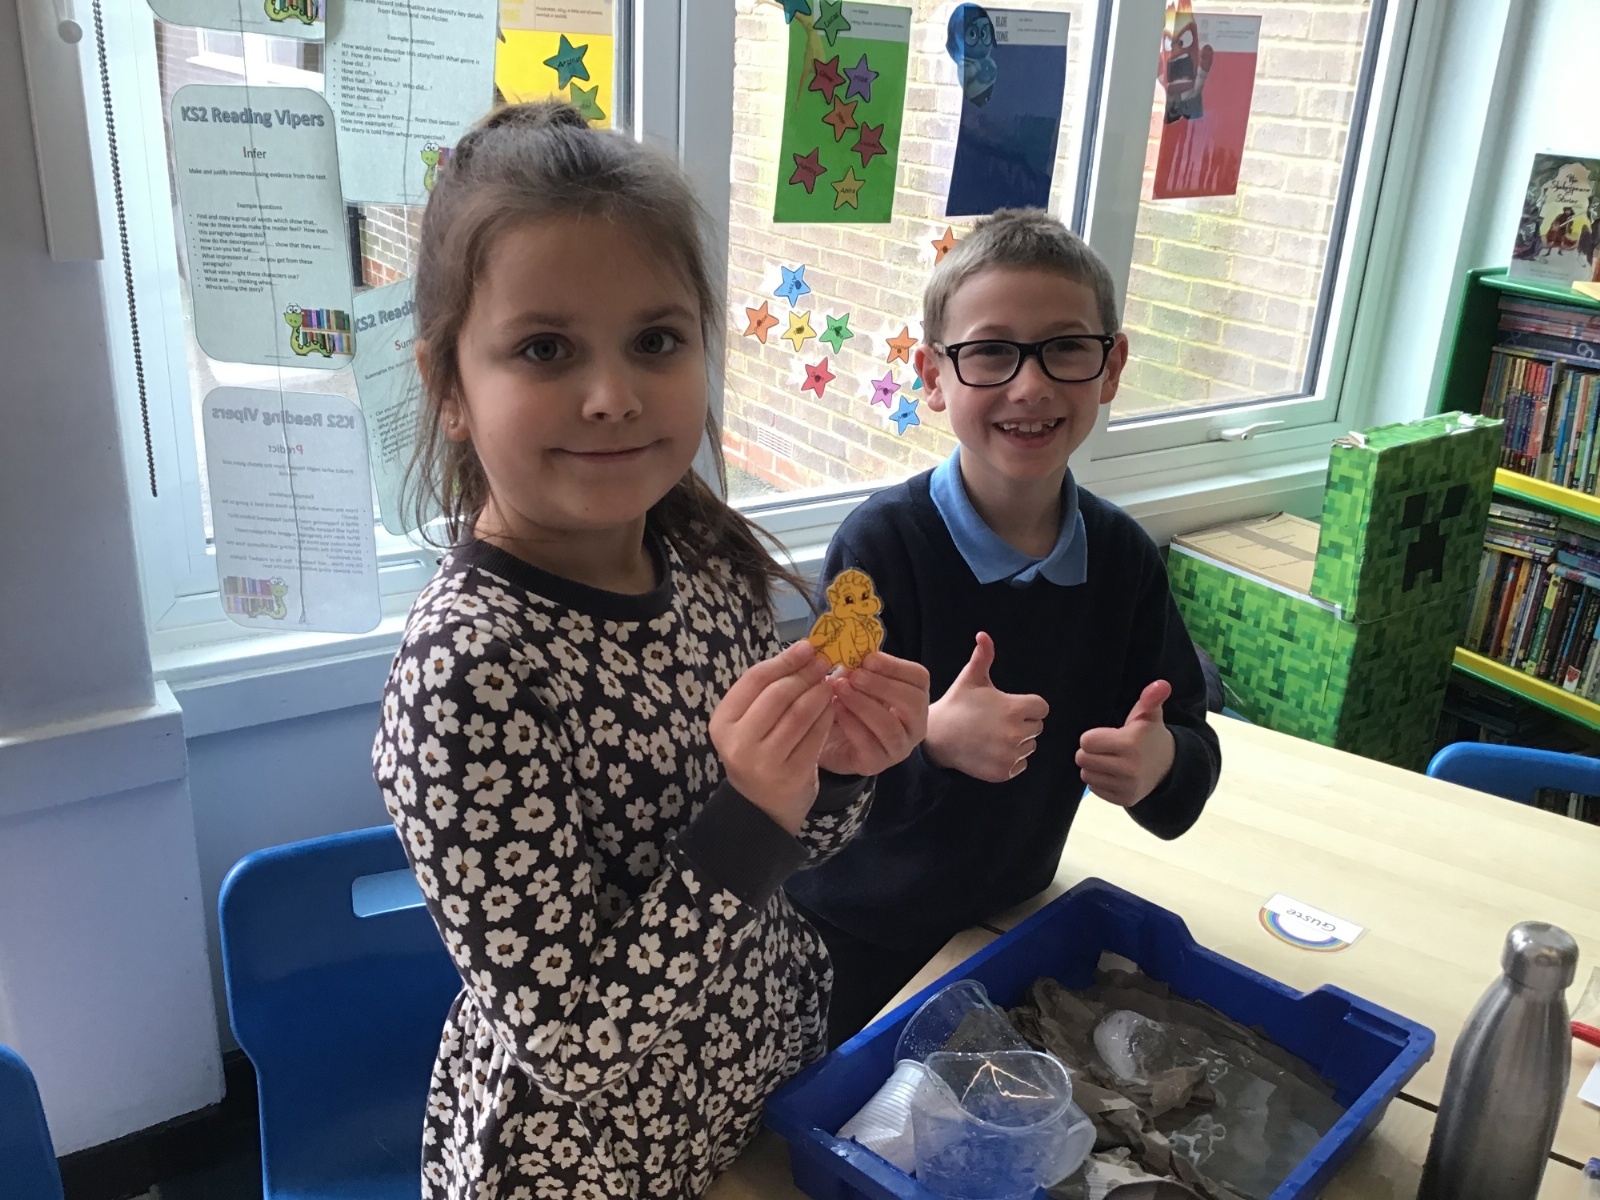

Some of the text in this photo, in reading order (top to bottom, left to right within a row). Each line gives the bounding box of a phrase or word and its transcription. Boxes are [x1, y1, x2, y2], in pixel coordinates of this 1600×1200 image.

[180, 105, 326, 130] KS2 Reading Vipers
[242, 146, 266, 160] Infer
[1550, 180, 1590, 196] Shakespeare
[1555, 193, 1579, 204] Stories
[378, 300, 416, 324] Readi
